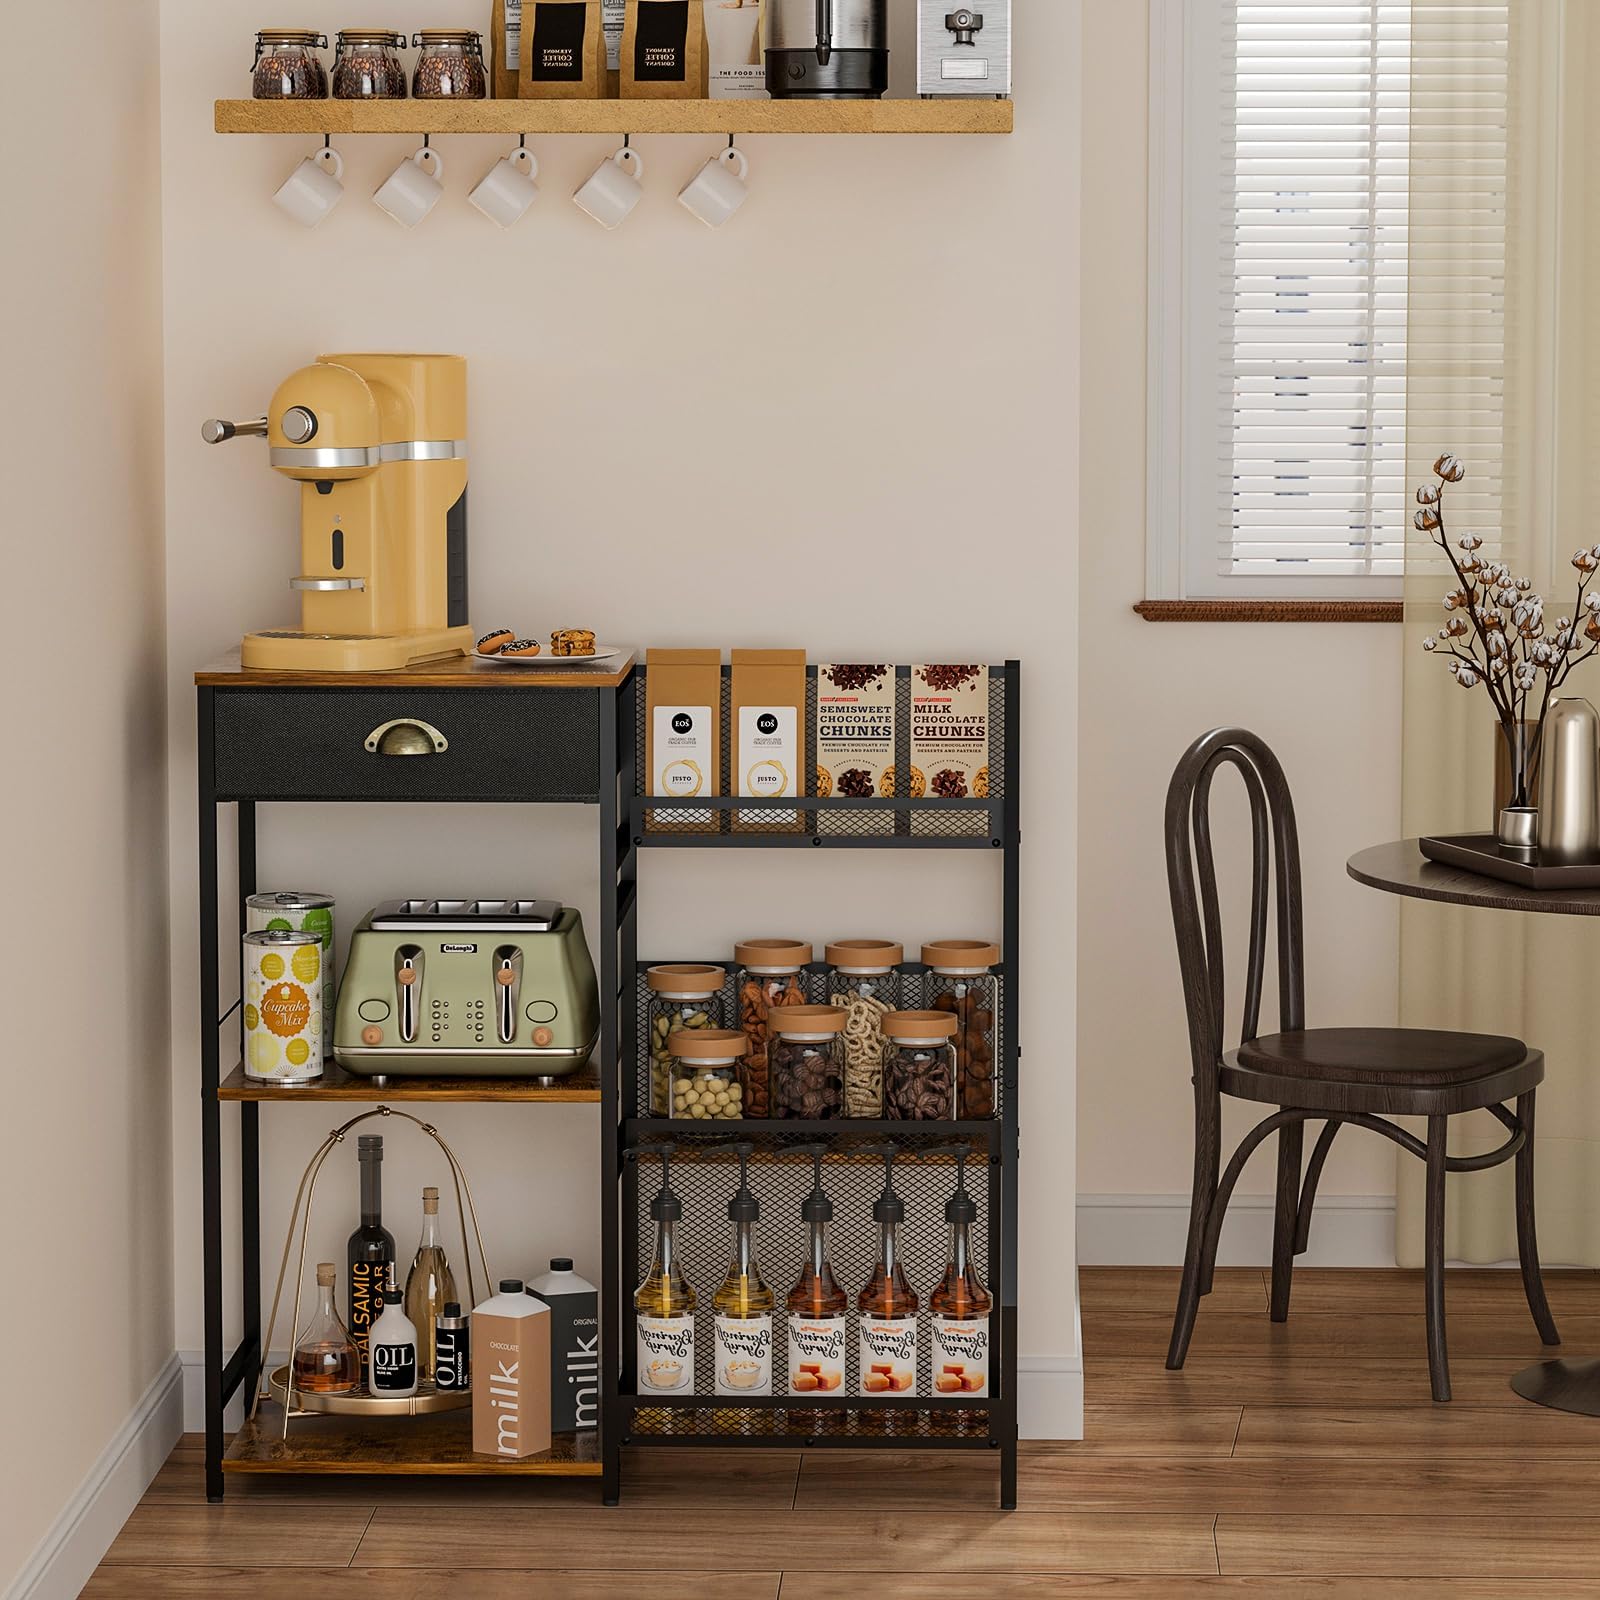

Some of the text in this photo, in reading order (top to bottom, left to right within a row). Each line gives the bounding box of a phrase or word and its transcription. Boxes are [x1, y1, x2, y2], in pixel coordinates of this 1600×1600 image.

[820, 706, 892, 714] SEMISWEET
[914, 705, 952, 714] MILK
[820, 715, 892, 723] CHOCOLATE
[913, 716, 986, 724] CHOCOLATE
[820, 725, 892, 737] CHUNKS
[913, 726, 986, 737] CHUNKS
[263, 999, 307, 1015] Cupcake
[276, 1013, 304, 1027] Mix
[573, 1318, 598, 1326] ORIGINAL
[490, 1341, 520, 1353] CHOCOLATE
[375, 1347, 414, 1367] OIL
[436, 1334, 456, 1386] OIL
[567, 1334, 598, 1427] milk
[490, 1360, 519, 1455] milk
